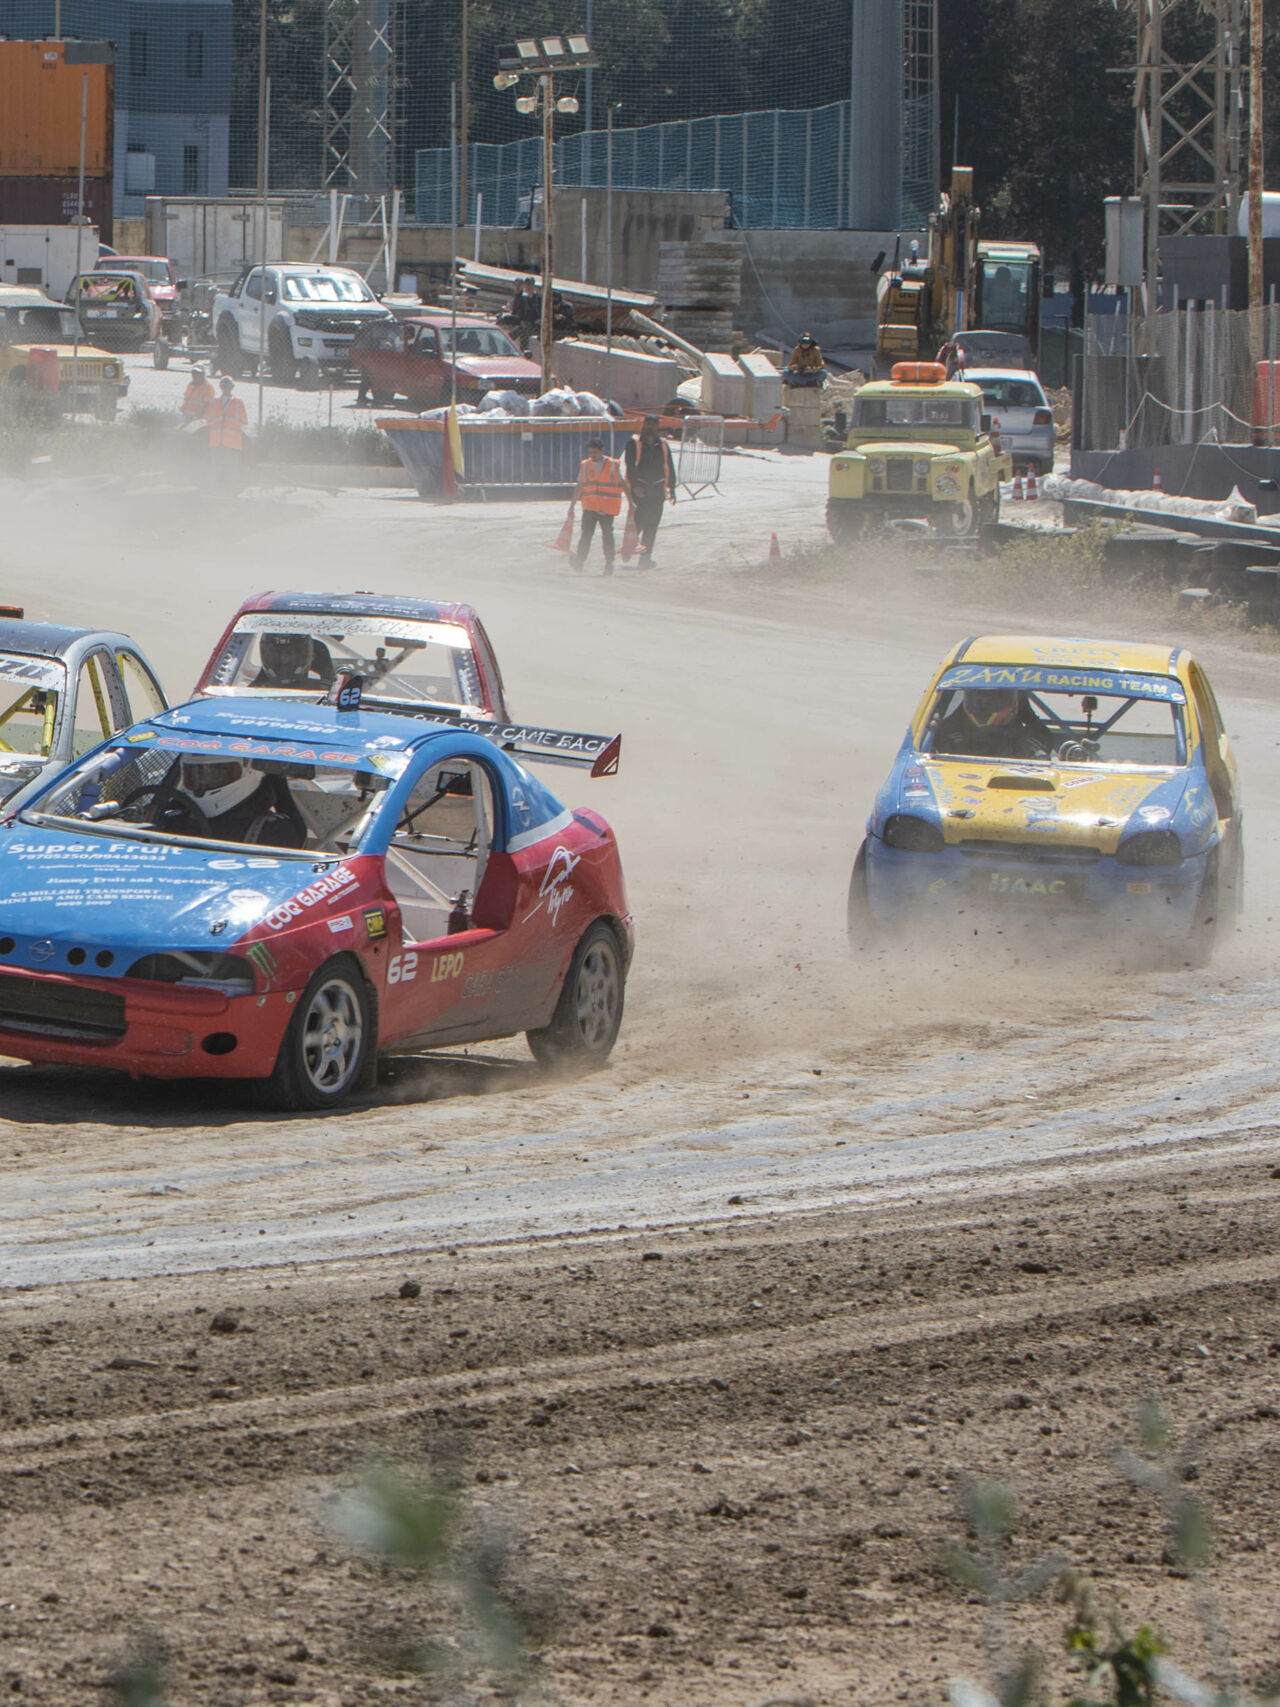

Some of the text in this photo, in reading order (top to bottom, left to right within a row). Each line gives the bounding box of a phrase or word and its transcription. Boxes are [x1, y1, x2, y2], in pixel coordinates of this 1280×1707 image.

[1047, 674, 1114, 689] RACING
[1119, 679, 1168, 695] TEAM
[340, 688, 361, 706] 62
[501, 727, 557, 745] CAME
[158, 737, 223, 750] COQ
[229, 741, 361, 763] GARAGE
[8, 843, 183, 855] Super Fruit
[207, 858, 281, 870] 62
[266, 901, 304, 930] COQ
[296, 866, 356, 907] GARAGE
[387, 951, 464, 985] 62 LEPO
